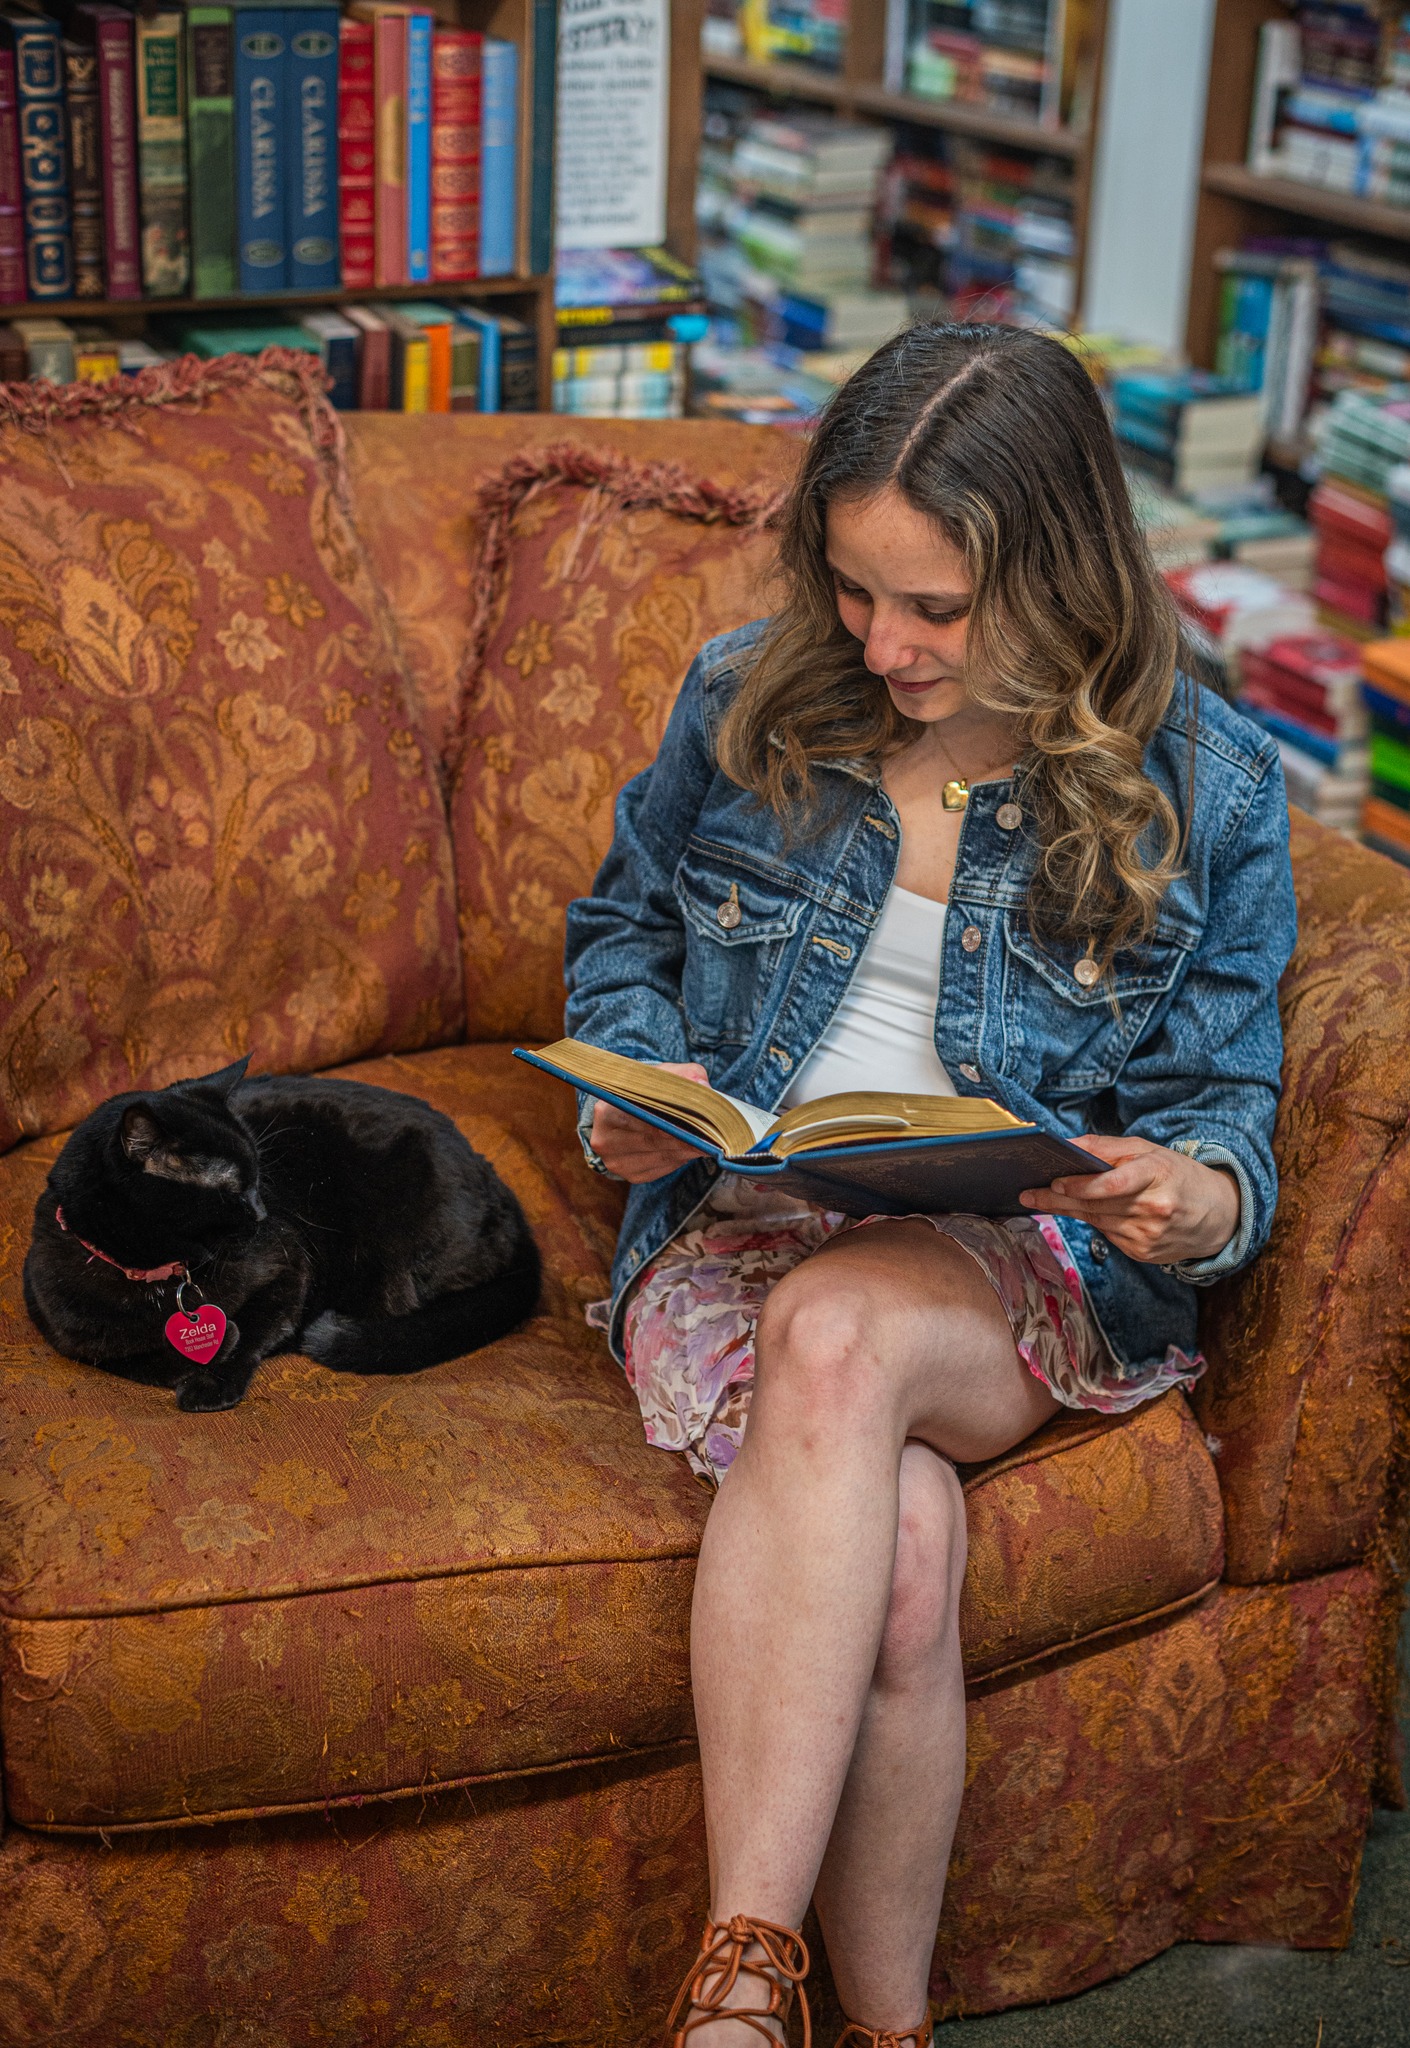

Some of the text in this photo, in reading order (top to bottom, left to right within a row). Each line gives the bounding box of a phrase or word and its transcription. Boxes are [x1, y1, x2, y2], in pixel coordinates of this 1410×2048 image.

[250, 76, 276, 219] CLARISSA
[301, 75, 327, 217] CLARISSA
[179, 1323, 216, 1339] Zelda
